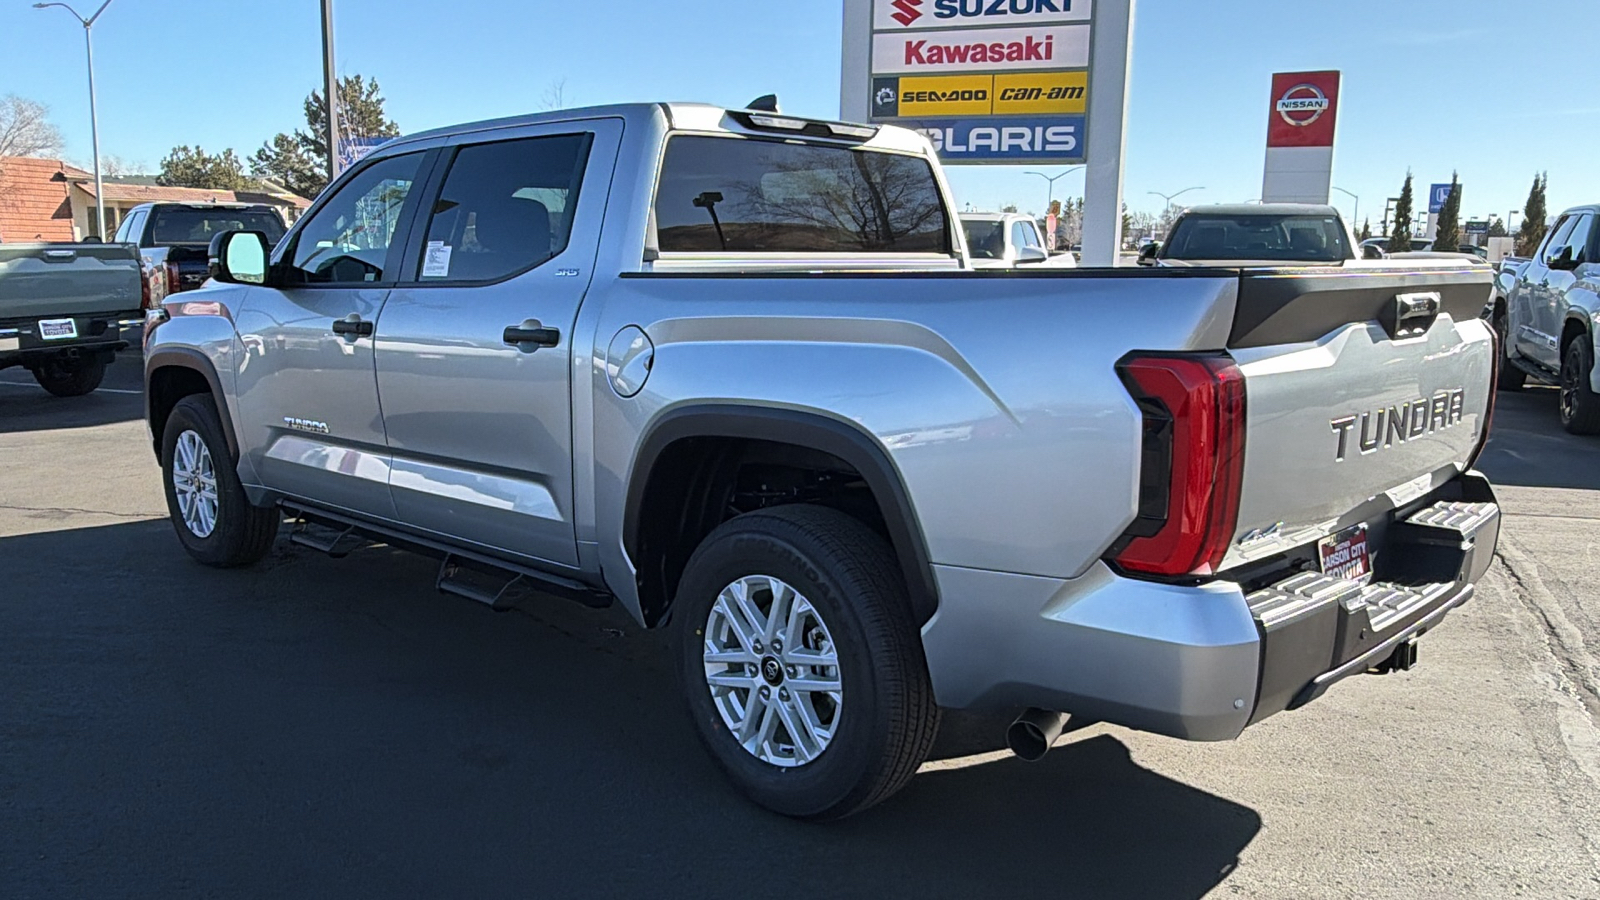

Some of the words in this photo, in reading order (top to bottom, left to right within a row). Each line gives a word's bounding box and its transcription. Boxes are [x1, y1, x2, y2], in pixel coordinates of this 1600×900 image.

[933, 0, 1071, 19] SUZUKI
[904, 35, 1054, 65] Kawasaki
[1281, 101, 1323, 109] NISSAN
[920, 126, 1076, 152] OLARIS
[1329, 387, 1464, 462] TUNDRA
[1350, 541, 1367, 558] CITY
